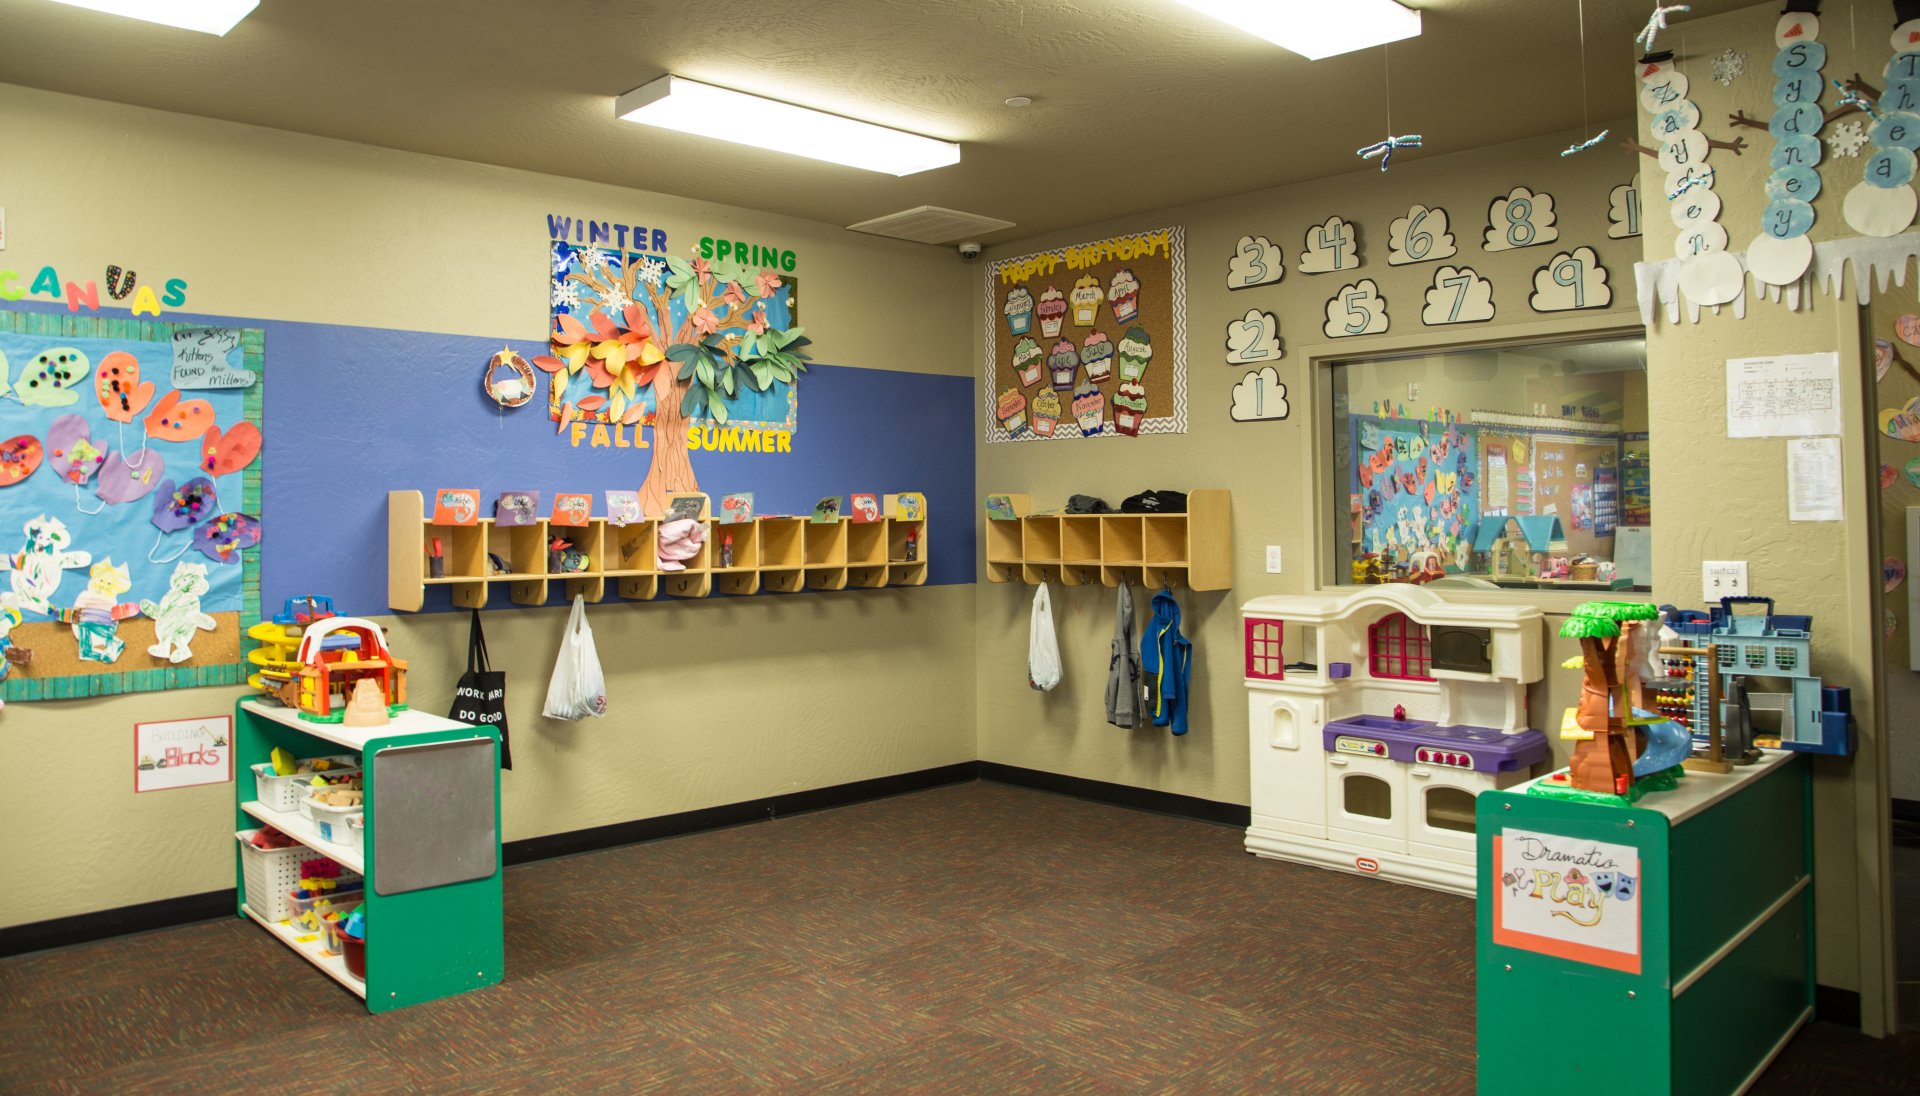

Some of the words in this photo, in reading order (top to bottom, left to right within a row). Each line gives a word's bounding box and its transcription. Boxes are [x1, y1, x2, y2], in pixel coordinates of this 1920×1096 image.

[1876, 54, 1920, 178] Thea
[1773, 46, 1808, 237] Sydney
[1506, 197, 1536, 247] 8
[1626, 189, 1643, 235] 1
[547, 214, 667, 253] WINTER
[1318, 224, 1347, 270] 4
[1405, 210, 1433, 260] 6
[700, 236, 797, 272] SPRING
[1000, 254, 1060, 285] HAPPY
[1065, 228, 1169, 270] BIRTHDAY!
[1243, 242, 1268, 285] 3
[1075, 290, 1097, 301] March
[1114, 283, 1131, 297] April
[1443, 275, 1472, 322] 7
[1553, 258, 1585, 308] 9
[1345, 291, 1371, 334] 5
[1086, 345, 1105, 358] July
[1124, 341, 1147, 356] August
[1240, 320, 1269, 360] 2
[174, 365, 205, 381] FOUND
[1075, 397, 1102, 412] November
[1256, 377, 1264, 417] 1
[571, 423, 650, 449] FALL
[687, 425, 792, 453] SUMMER
[459, 709, 476, 721] DO
[479, 711, 503, 723] GOOD
[1514, 836, 1620, 869] Dramatic
[1529, 868, 1609, 928] Play
